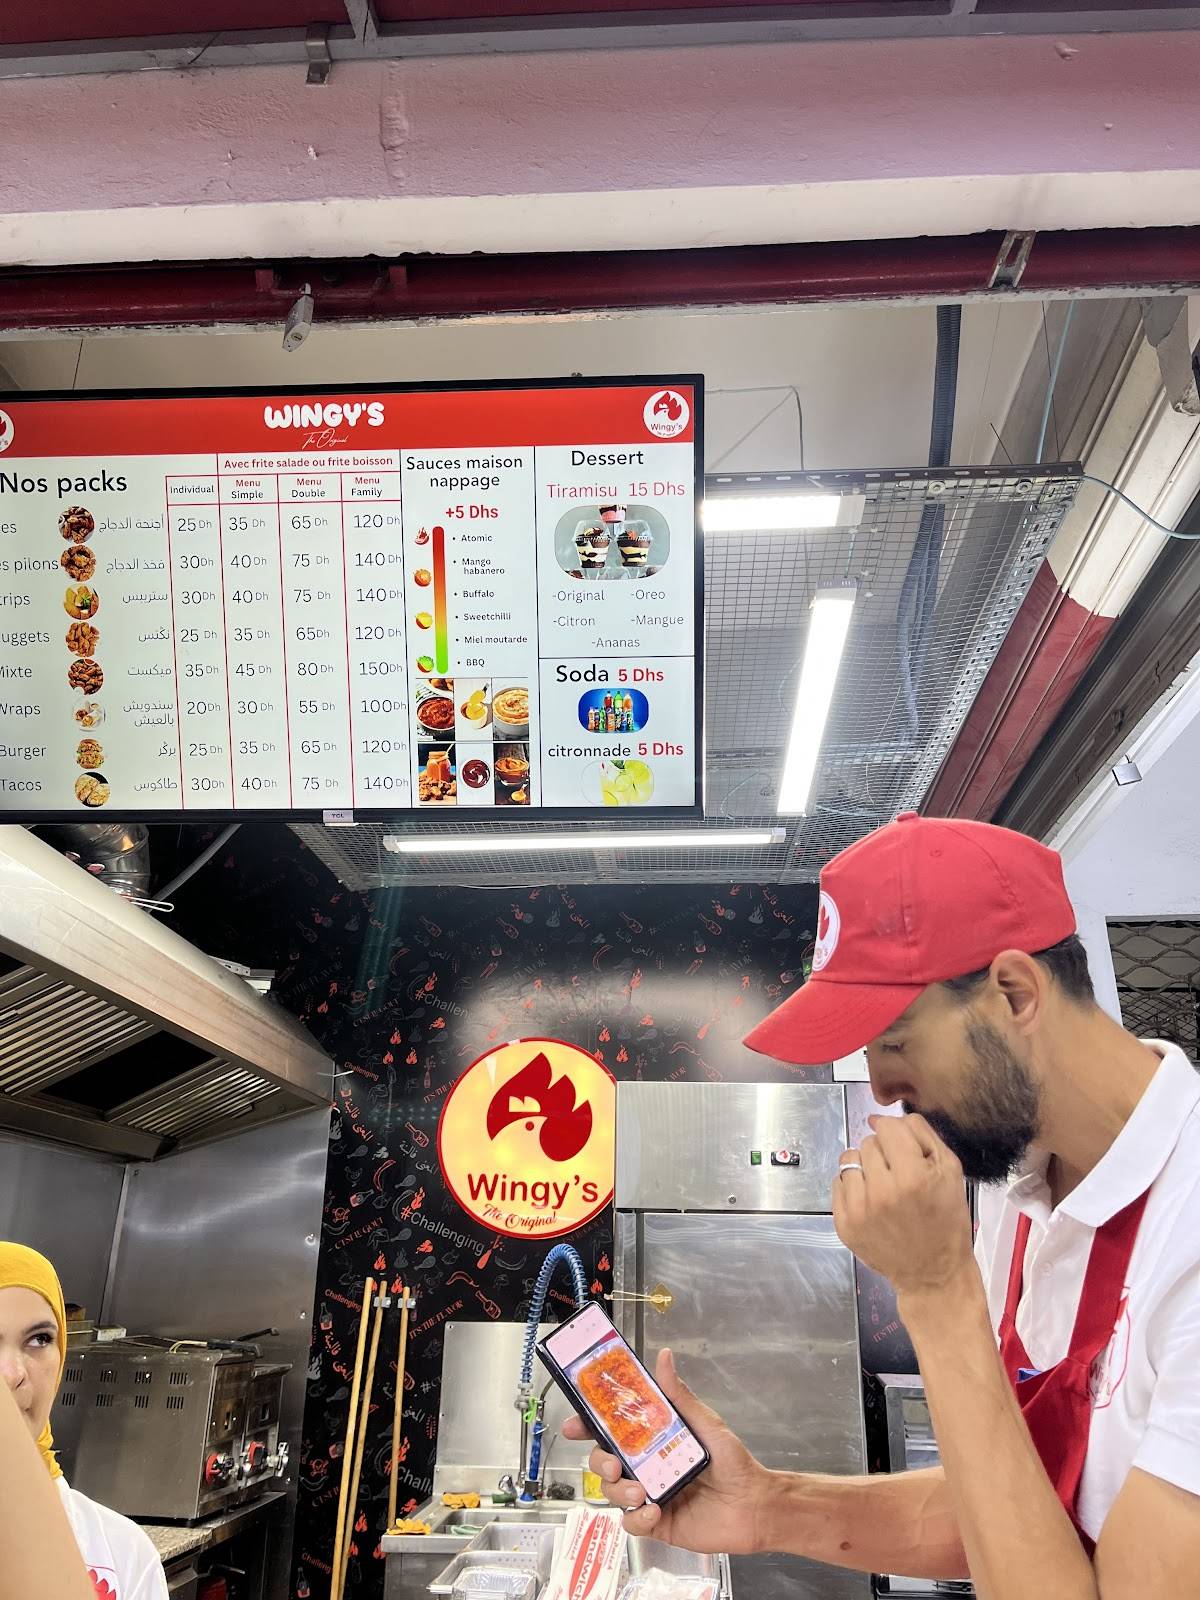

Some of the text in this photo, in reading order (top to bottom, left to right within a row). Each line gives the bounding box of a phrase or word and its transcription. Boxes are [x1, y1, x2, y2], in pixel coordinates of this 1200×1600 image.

[263, 401, 385, 429] WINGY'S
[650, 422, 683, 432] Wingy's
[224, 456, 393, 469] Avec frite salade ou frite boisson
[406, 454, 523, 470] Sauces maison
[571, 450, 644, 466] Dessert
[0, 469, 128, 499] Nos packs
[235, 479, 261, 487] Menu
[296, 478, 322, 486] Menu
[354, 476, 380, 485] Menu
[430, 476, 500, 491] nappage
[170, 484, 214, 494] Individual
[231, 490, 263, 501] Simple
[291, 489, 326, 498] Double
[351, 487, 384, 499] Family
[546, 481, 685, 499] Tiramisu 15 Dhs
[445, 504, 499, 519] +5 Dhs
[98, 517, 132, 533] الدجاج
[177, 518, 212, 532] 25 Dh
[229, 516, 266, 531] 35 Dh
[291, 515, 328, 530] 65 Dh
[354, 514, 401, 528] 120 Dh
[461, 534, 492, 542] Atomic
[14, 557, 59, 574] pilons
[106, 558, 165, 574] فخذ الدجاج
[230, 554, 267, 569] 40 Dh
[293, 553, 330, 567] 75 Dh
[355, 552, 402, 567] 140 Dh
[461, 558, 491, 568] Mango
[464, 566, 505, 575] habanero
[232, 590, 269, 604] 40 Dh
[293, 589, 331, 603] 75 Dh
[356, 588, 403, 602] 140 Dh
[463, 589, 495, 598] Buffalo
[463, 612, 511, 621] Sweetchilli
[180, 629, 217, 643] 25 Dh
[234, 627, 270, 641] 35 Dh
[355, 626, 402, 640] 120 Dh
[464, 635, 528, 644] Miel moutarde
[235, 663, 272, 677] 45 Dh
[297, 662, 334, 676] 80 Dh
[466, 658, 485, 668] BBQ
[185, 663, 219, 678] 35 Dh
[556, 663, 664, 683] Soda 5 Dhs
[237, 700, 274, 714] 30 Dh
[299, 700, 336, 714] 55 Dh
[0, 744, 47, 761] Burger
[189, 743, 223, 757] 25 Dh
[239, 741, 276, 755] 35 Dh
[301, 740, 337, 754] 65 Dh
[362, 740, 407, 754] 120 Dh
[548, 742, 684, 757] citronnade 5 Dhs
[1, 778, 42, 791] Tacos
[134, 777, 178, 792] طاكوس
[241, 777, 277, 791] 40 Dh
[302, 777, 339, 790] 75 Dh
[364, 776, 409, 790] 140 Dh
[467, 1173, 598, 1210] Wingy's
[481, 1203, 557, 1231] The Original
[400, 1206, 485, 1257] #Challenging
[573, 1511, 607, 1600] Sandwich
